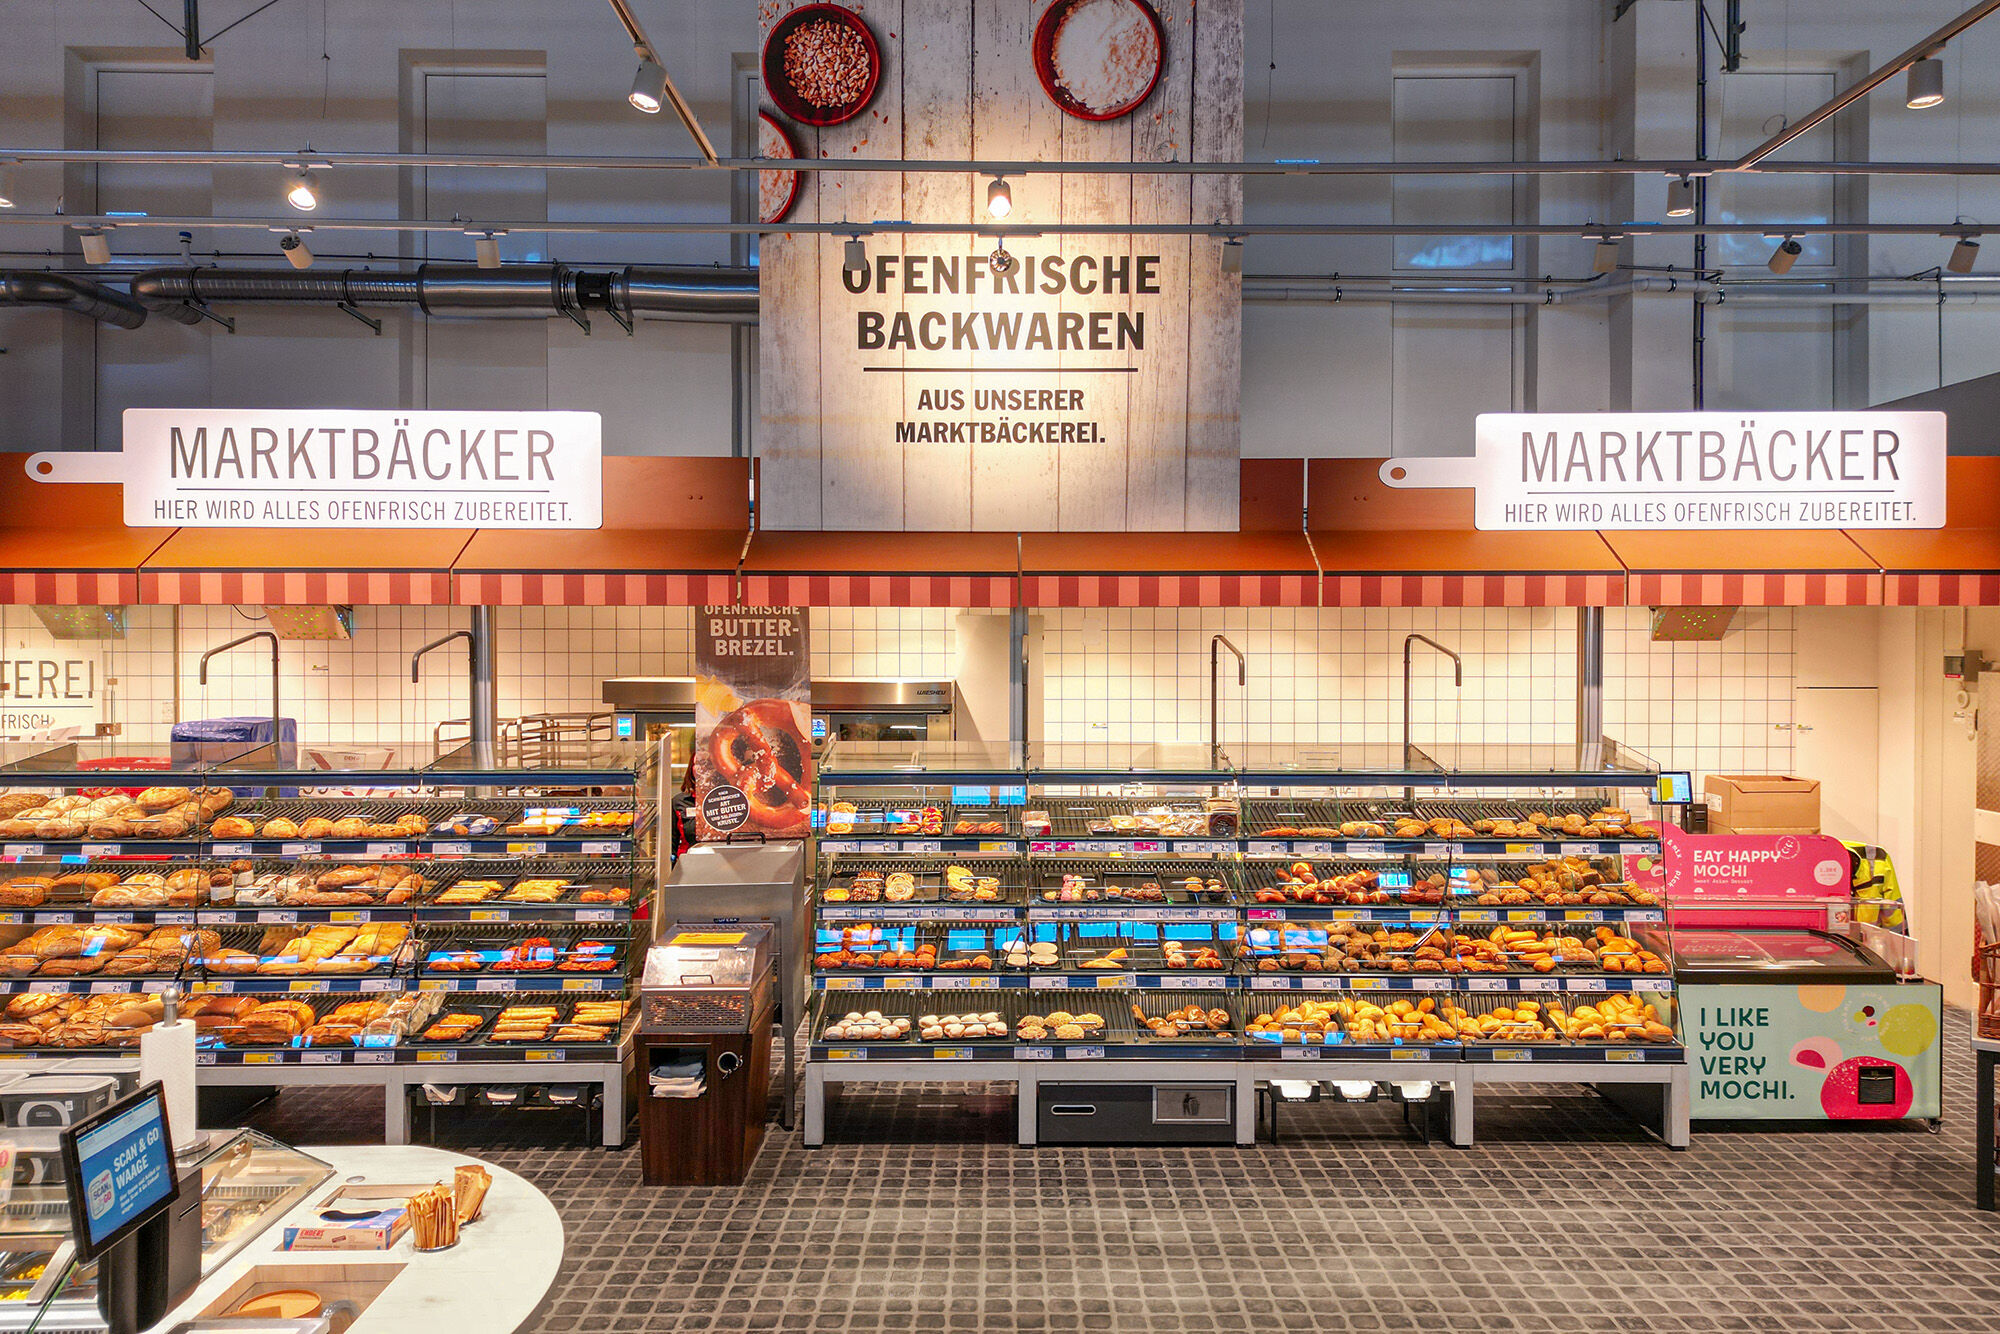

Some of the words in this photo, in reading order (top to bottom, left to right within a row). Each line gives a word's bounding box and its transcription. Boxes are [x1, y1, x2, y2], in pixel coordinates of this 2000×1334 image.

[842, 256, 1160, 294] OFENFRISCHE
[857, 312, 1144, 350] BACKWAREN
[917, 389, 965, 411] AUS
[975, 389, 1084, 411] UNSERER
[895, 416, 1106, 444] MARKTBÄCKEREI.
[170, 418, 555, 481] MARKTBÄCKER
[1521, 420, 1900, 483] MARKTBÄCKER
[154, 499, 197, 520] HIER
[205, 500, 255, 520] WIRD
[262, 500, 320, 521] ALLES
[328, 500, 445, 521] OFENFRISCH
[454, 501, 572, 522] ZUBEREITET.
[1505, 503, 1548, 523] HIER
[1555, 503, 1603, 523] WIRD
[1610, 502, 1667, 523] ALLES
[1674, 502, 1790, 522] OFENFRISCH
[1799, 501, 1917, 522] ZUBEREITET.
[704, 606, 800, 615] OFENFRISCHE
[710, 618, 799, 637] BUTTER-
[715, 639, 794, 656] BREZEL.
[706, 808, 719, 816] MIT
[720, 804, 746, 814] BUTTER
[1693, 850, 1724, 863] EAT
[1728, 849, 1783, 863] HAPPY
[1693, 864, 1747, 877] MOCHI
[1700, 1007, 1706, 1027] I
[1716, 1007, 1770, 1027] LIKE
[1699, 1031, 1754, 1052] YOU
[1699, 1055, 1767, 1076] VERY
[1700, 1080, 1795, 1100] MOCHI.
[113, 1147, 138, 1172] SCAN
[139, 1137, 146, 1152] &
[146, 1127, 160, 1146] GO
[116, 1154, 149, 1190] WAAGE
